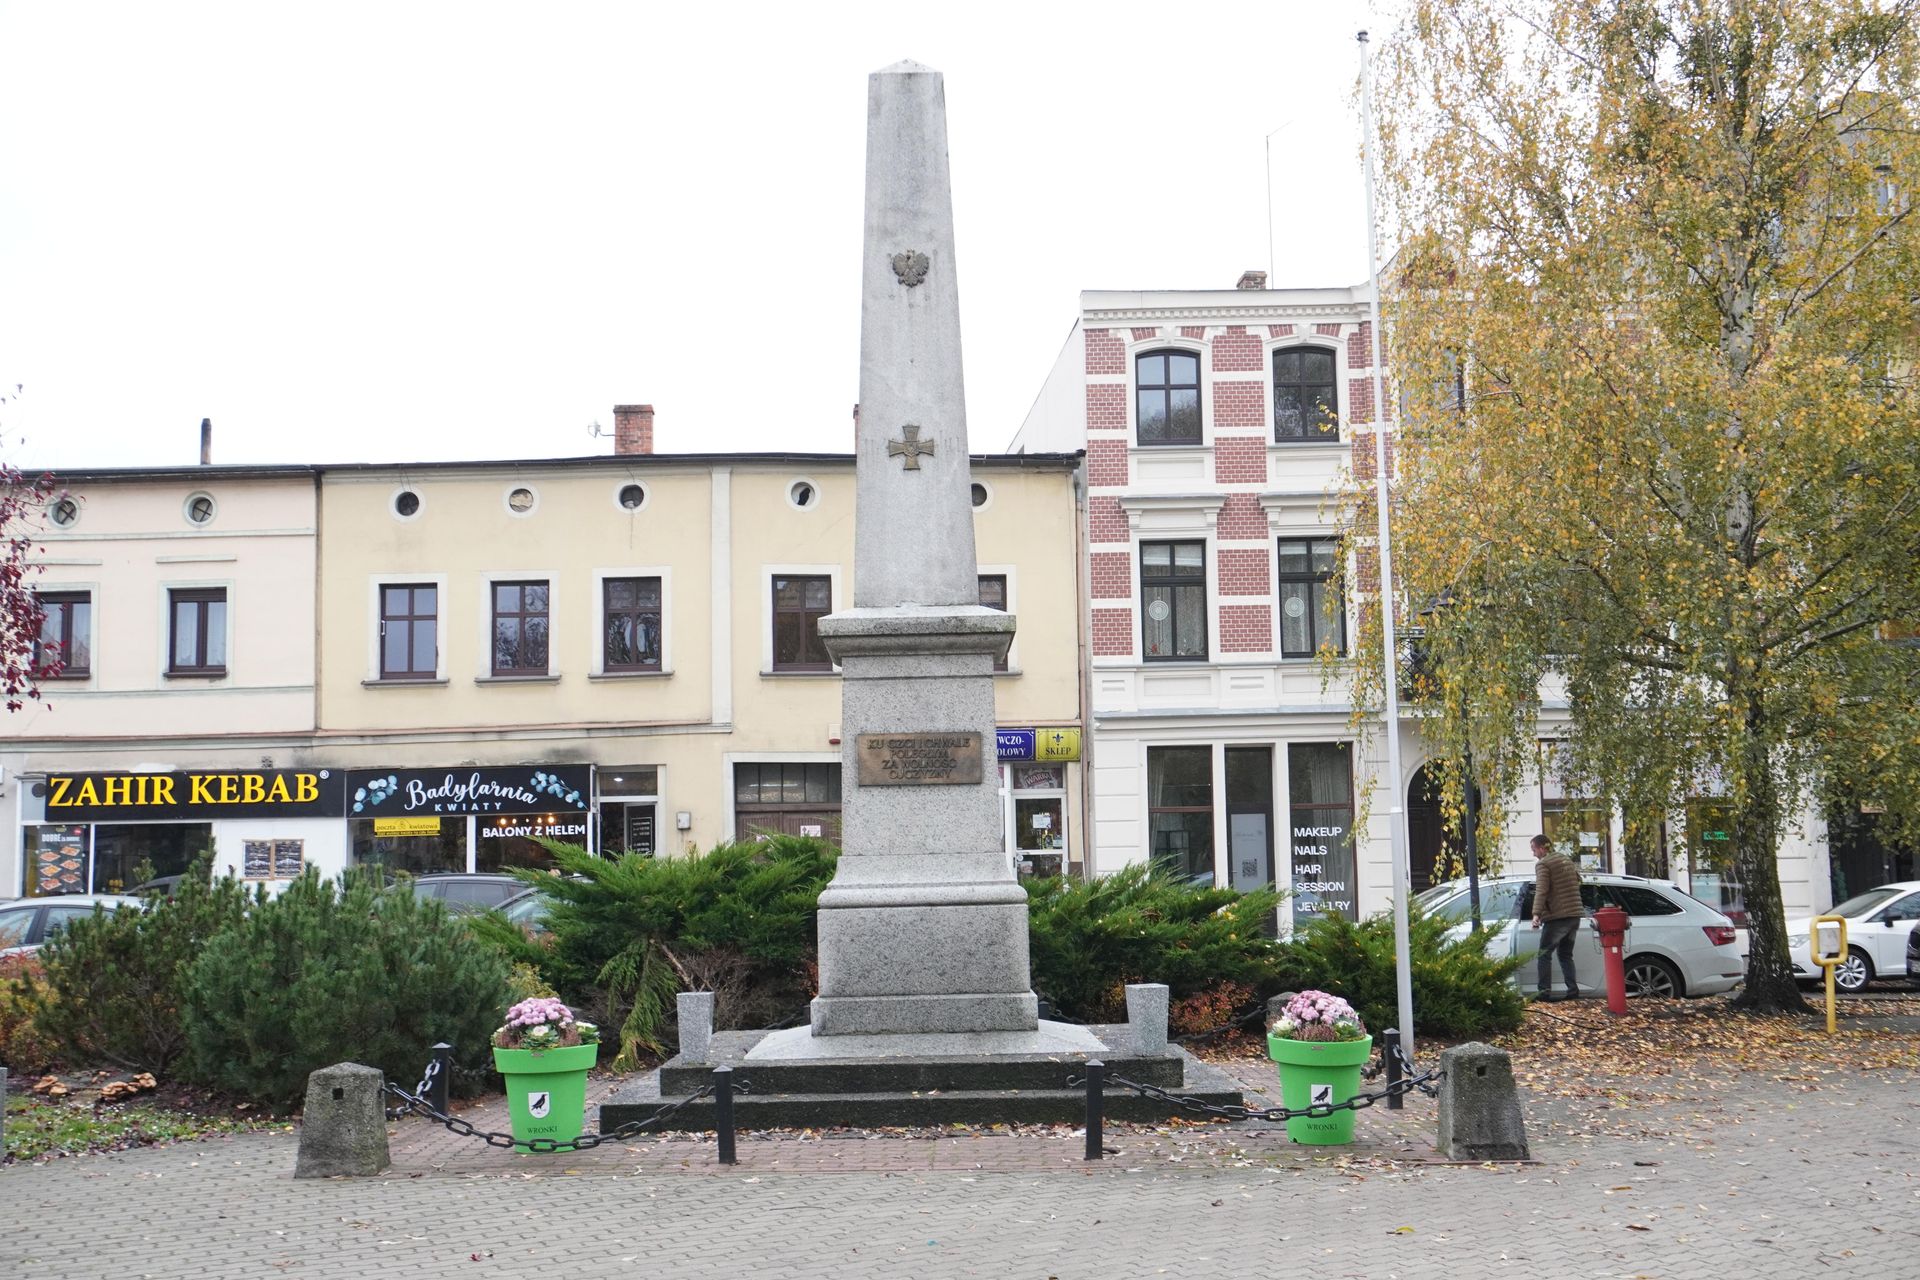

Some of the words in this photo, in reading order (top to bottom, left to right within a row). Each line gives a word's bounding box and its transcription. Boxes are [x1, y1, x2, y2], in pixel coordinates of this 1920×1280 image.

[1045, 747, 1072, 756] SKLEP
[882, 759, 898, 769] ZA
[48, 775, 177, 807] ZAHIR
[404, 772, 538, 810] Badylarnia
[435, 802, 502, 812] KWIATY
[482, 826, 532, 838] BALONY
[534, 826, 543, 836] Z
[545, 824, 586, 836] HELEM
[1294, 827, 1343, 837] MAKEUP
[1294, 845, 1328, 856] NAILS
[1295, 864, 1322, 875] HAIR
[1296, 882, 1345, 893] SESSION
[527, 1126, 558, 1134] WRONKI
[1306, 1123, 1338, 1131] WRONKI
